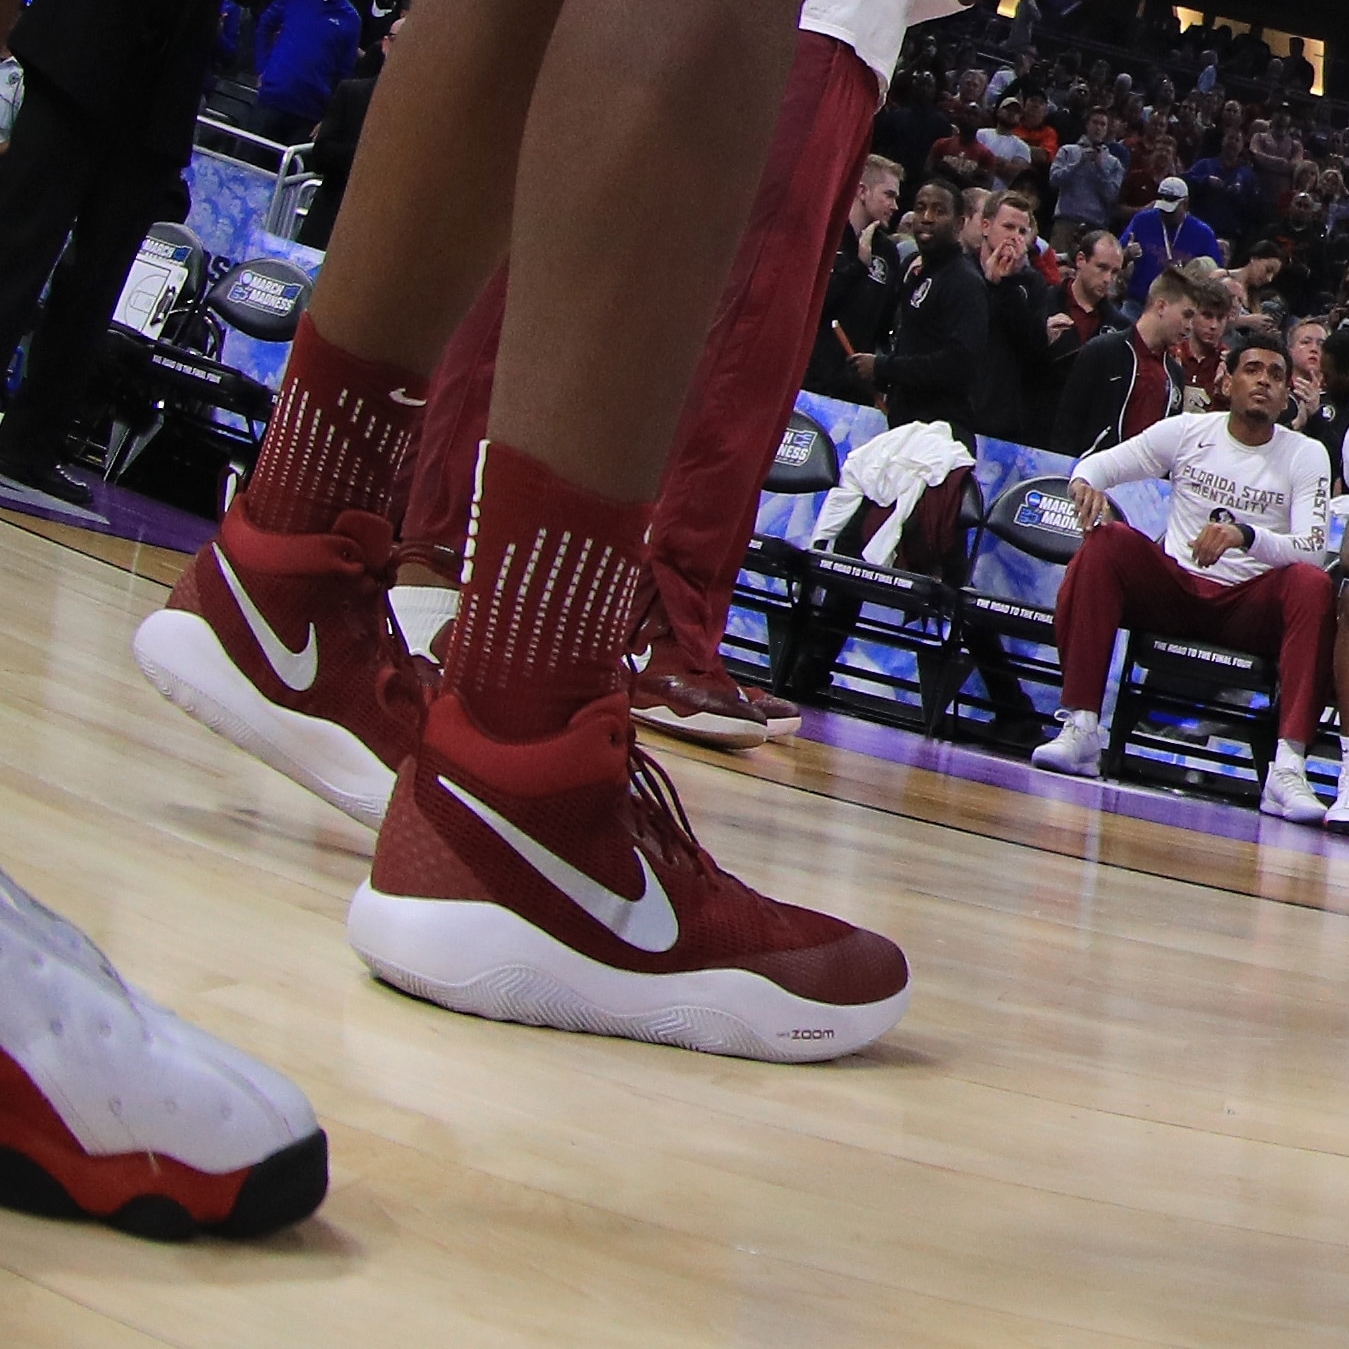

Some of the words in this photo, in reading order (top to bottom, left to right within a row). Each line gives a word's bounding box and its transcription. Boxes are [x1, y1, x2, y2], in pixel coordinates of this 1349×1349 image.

[1183, 465, 1237, 494] FLORIDA
[1242, 485, 1285, 506] STATE
[1190, 482, 1269, 515] MENTALITY
